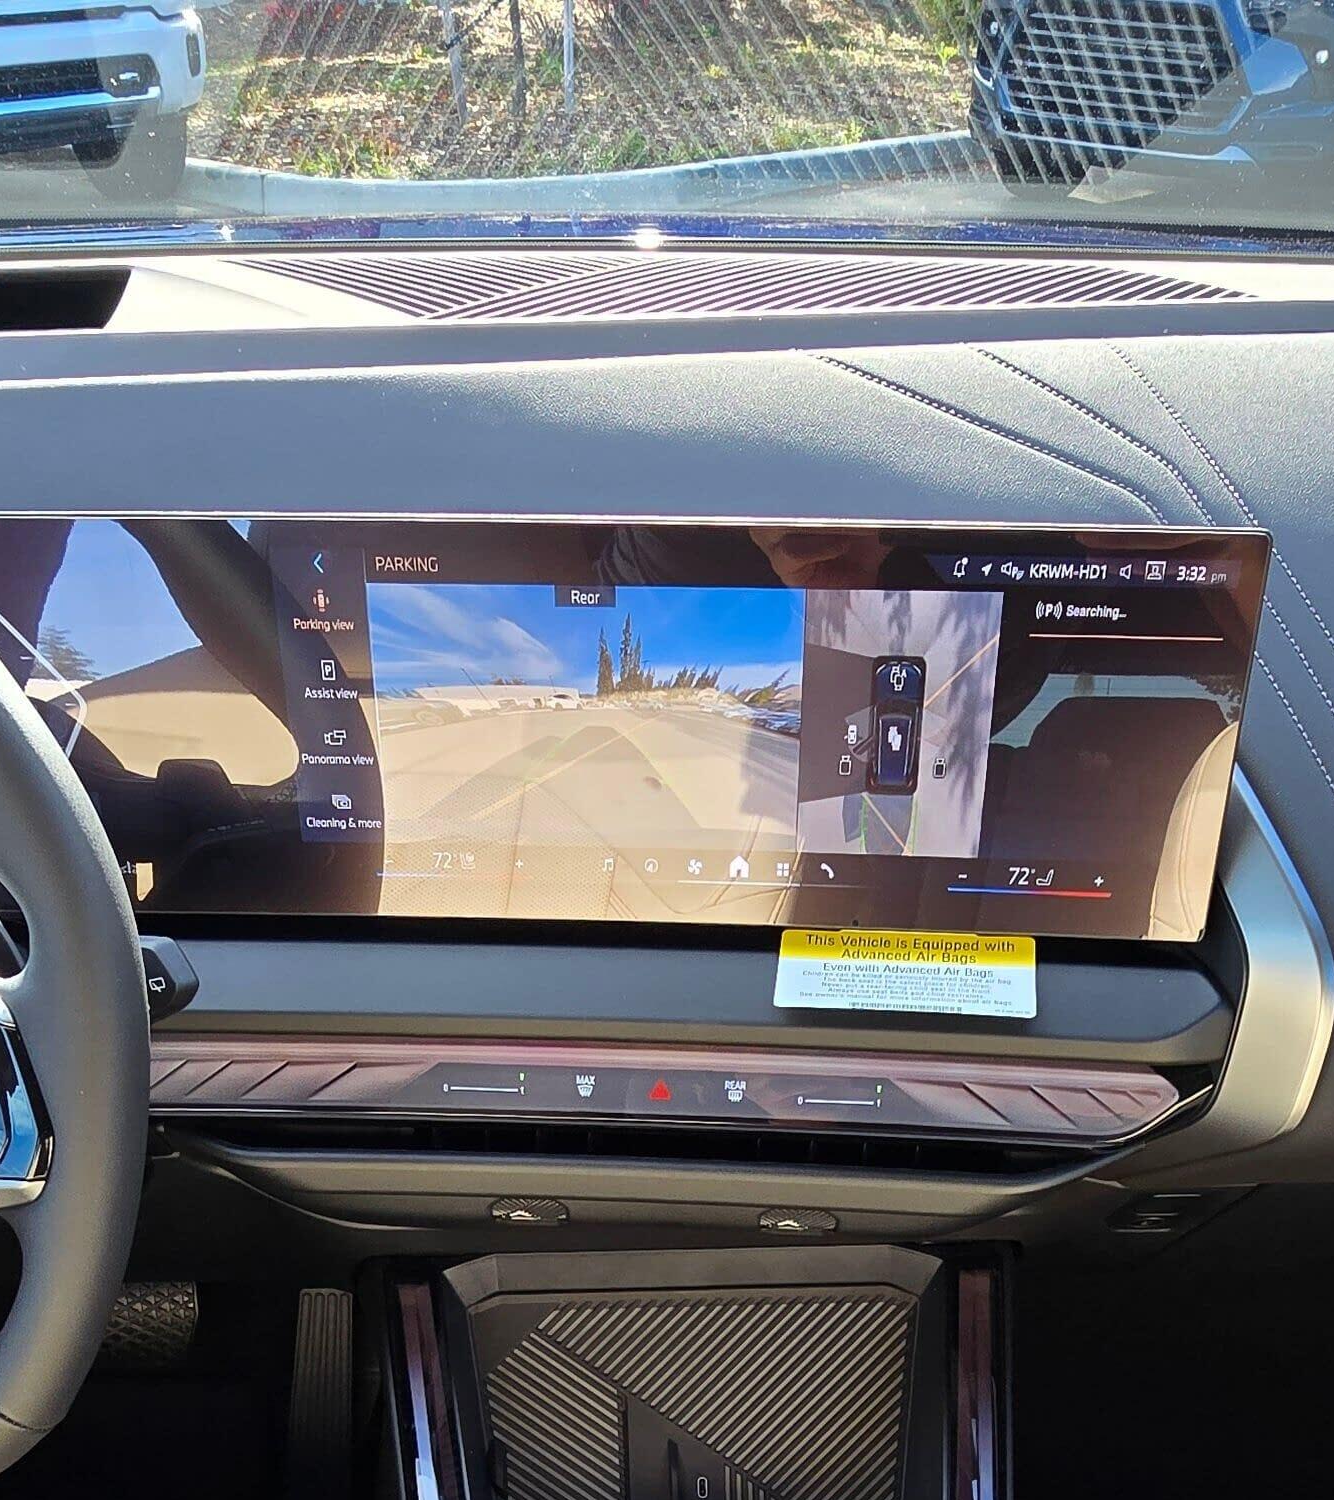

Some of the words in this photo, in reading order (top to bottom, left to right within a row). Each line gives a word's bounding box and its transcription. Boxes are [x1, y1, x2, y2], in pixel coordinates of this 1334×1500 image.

[375, 556, 439, 572] PARKING
[1029, 564, 1108, 580] KRWM-HD1
[1176, 565, 1207, 581] 3:32
[1210, 571, 1227, 583] pm
[570, 590, 601, 605] Rear
[293, 618, 331, 632] Parking
[332, 619, 354, 630] view
[304, 687, 334, 699] Assist
[335, 688, 358, 699] view
[302, 753, 350, 766] Panorama
[352, 754, 374, 766] view
[306, 817, 347, 830] Cleaning
[348, 818, 356, 829] &
[357, 819, 382, 829] more
[806, 934, 835, 946] This
[840, 935, 891, 948] Vehicle
[896, 938, 907, 949] is
[913, 938, 980, 952] Equipped
[985, 940, 1015, 953] with
[841, 949, 911, 961] Advanced
[916, 951, 937, 962] Air
[941, 952, 977, 965] Bags
[823, 962, 851, 972] Even
[855, 962, 880, 973] with
[883, 964, 941, 976] Advanced
[944, 966, 961, 976] Air
[966, 967, 994, 979] Bags
[576, 1075, 596, 1085] MAX
[724, 1080, 746, 1091] REAR
